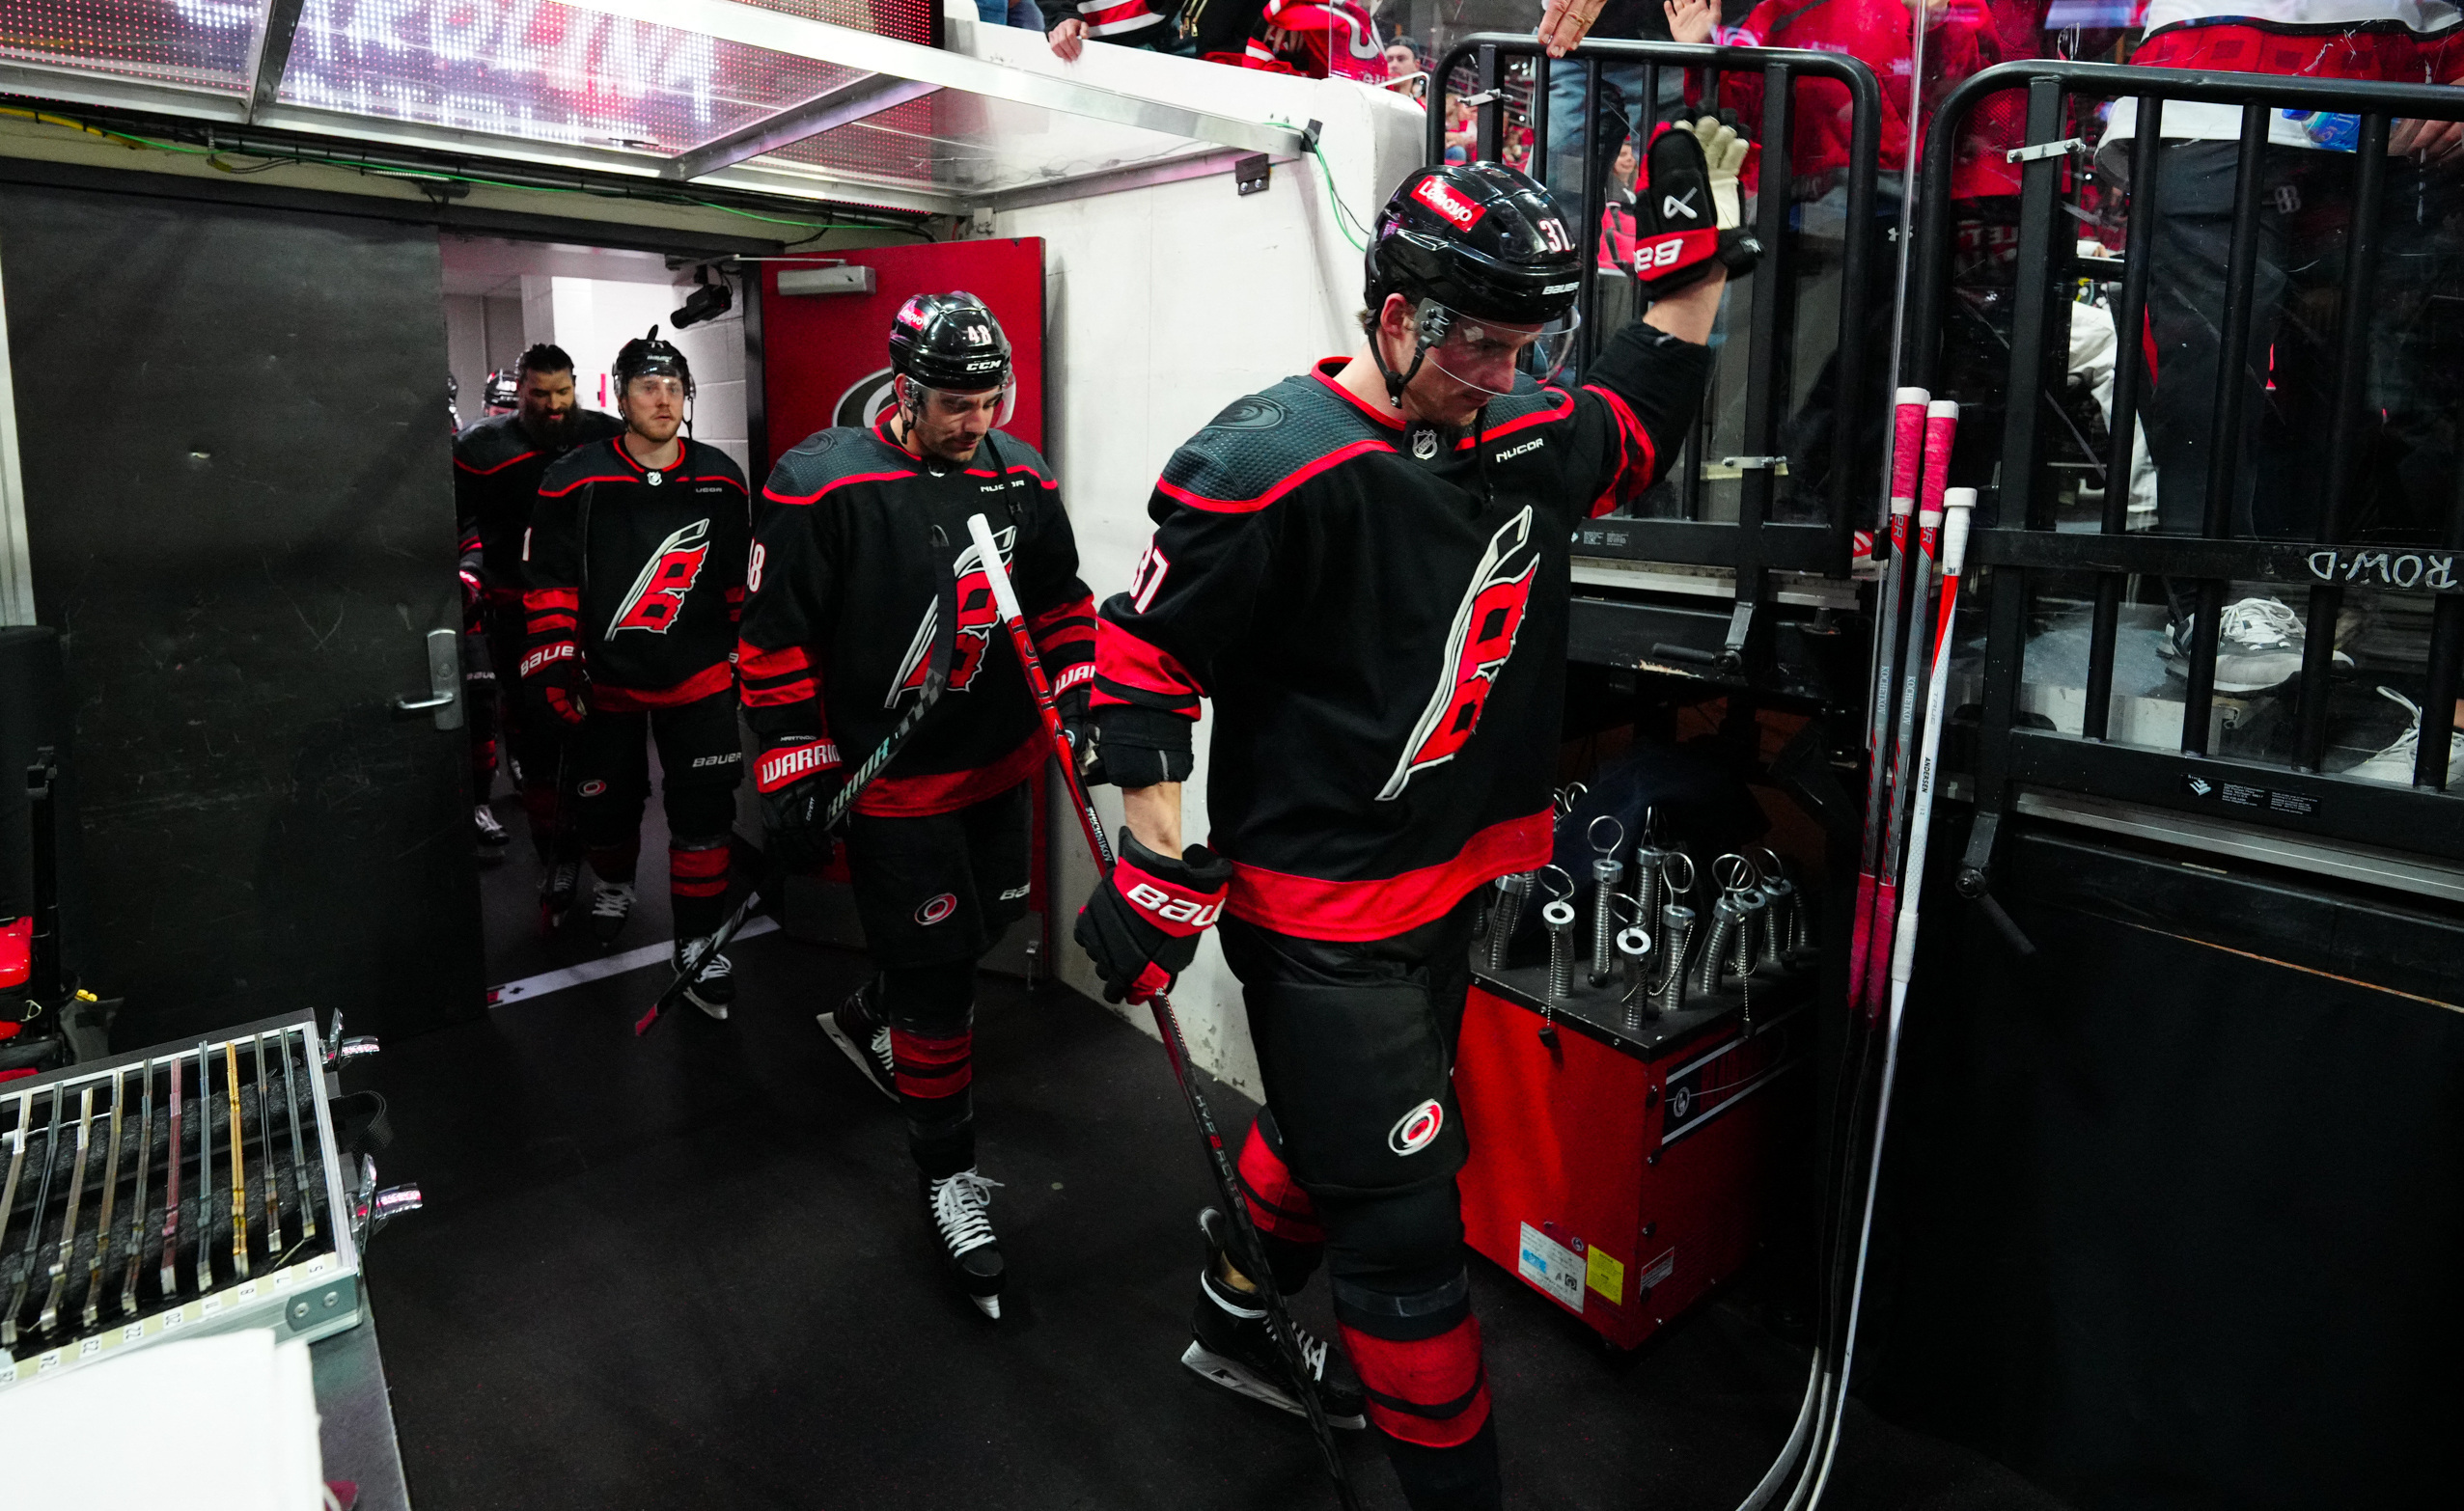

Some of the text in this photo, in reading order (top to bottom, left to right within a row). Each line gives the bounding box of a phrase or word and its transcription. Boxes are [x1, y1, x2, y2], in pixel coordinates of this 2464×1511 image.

[1419, 180, 1473, 222] Lenovo
[1538, 218, 1571, 253] 37
[967, 325, 992, 344] 48
[966, 360, 1002, 371] CCM
[1495, 437, 1544, 463] NUCOR
[1876, 665, 1890, 715] KOCHETKOV
[1902, 674, 1916, 726] KOCHETKOV
[1930, 692, 1939, 726] TRUE
[1922, 756, 1931, 794] ANDERSEN
[125, 1324, 143, 1339] 22
